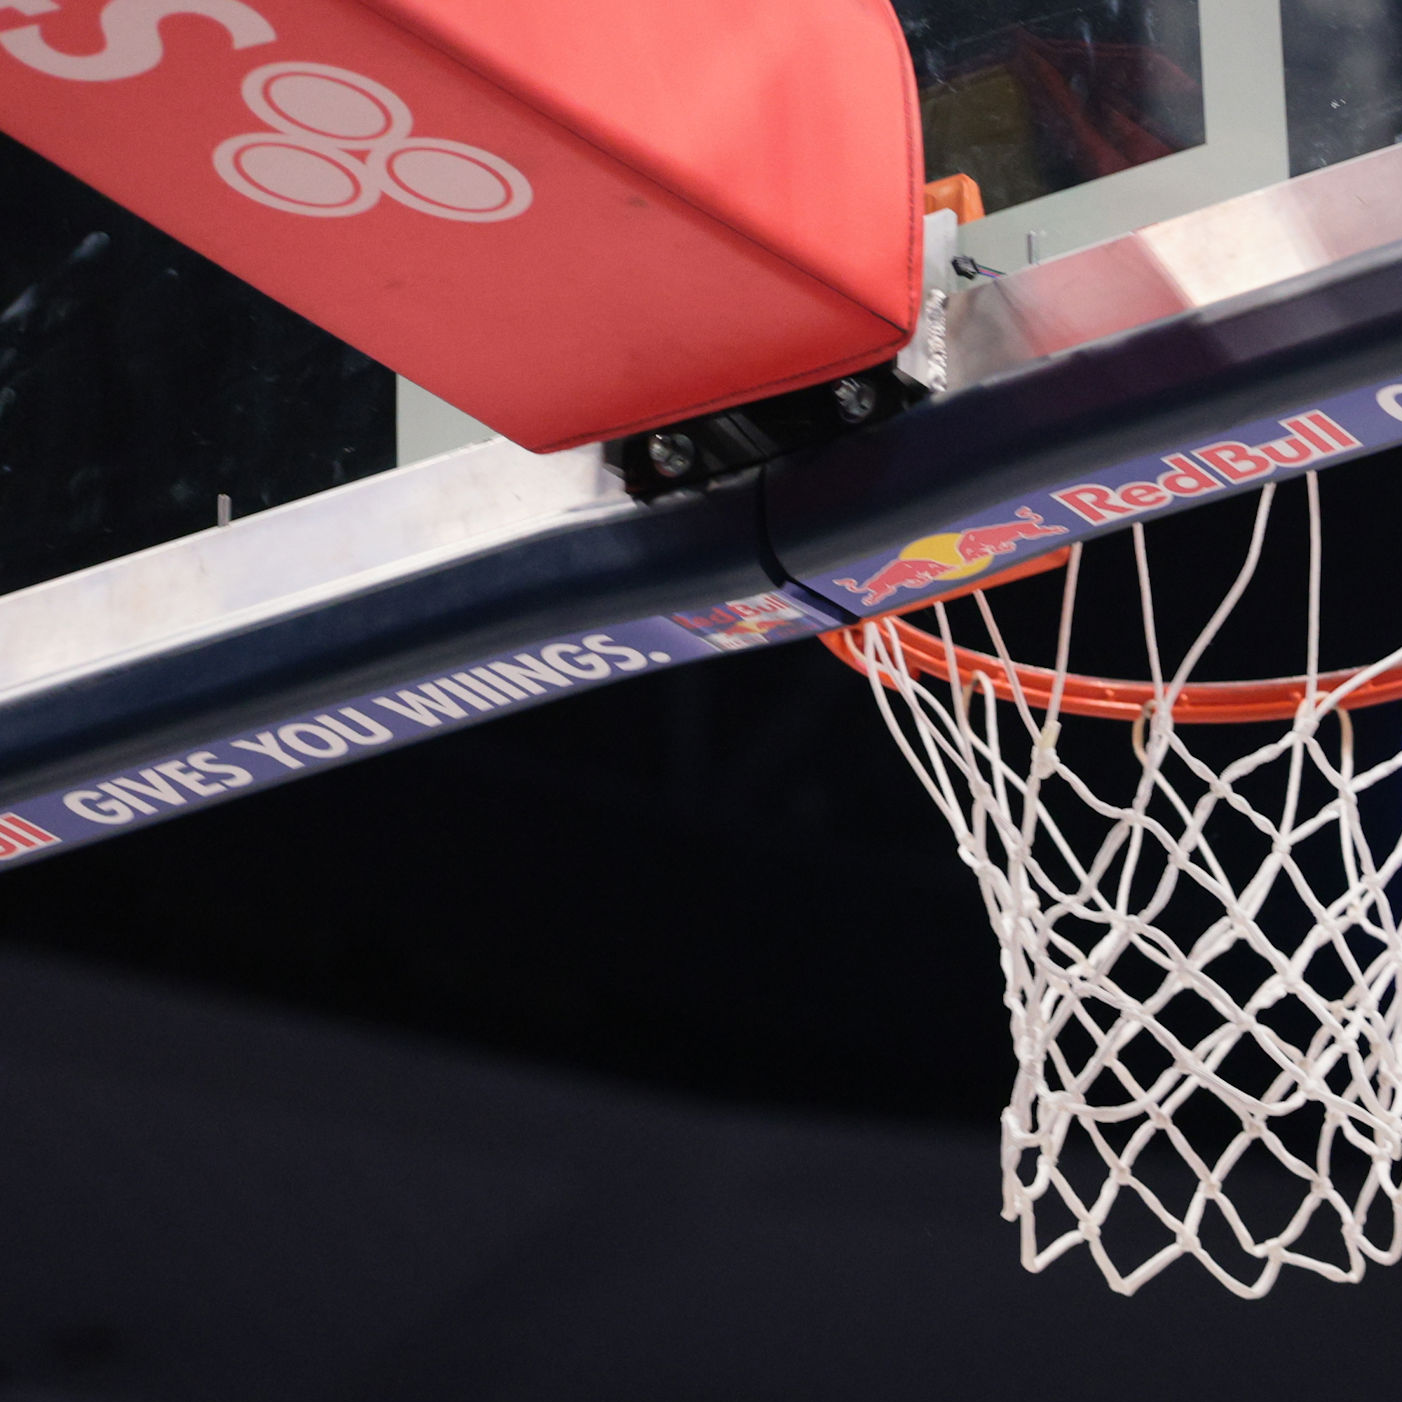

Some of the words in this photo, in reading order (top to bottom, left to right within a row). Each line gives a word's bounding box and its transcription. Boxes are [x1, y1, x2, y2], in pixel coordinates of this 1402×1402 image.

[62, 751, 254, 825] GIVES
[229, 706, 394, 771] YOU
[372, 633, 672, 730] WIIINGS.
